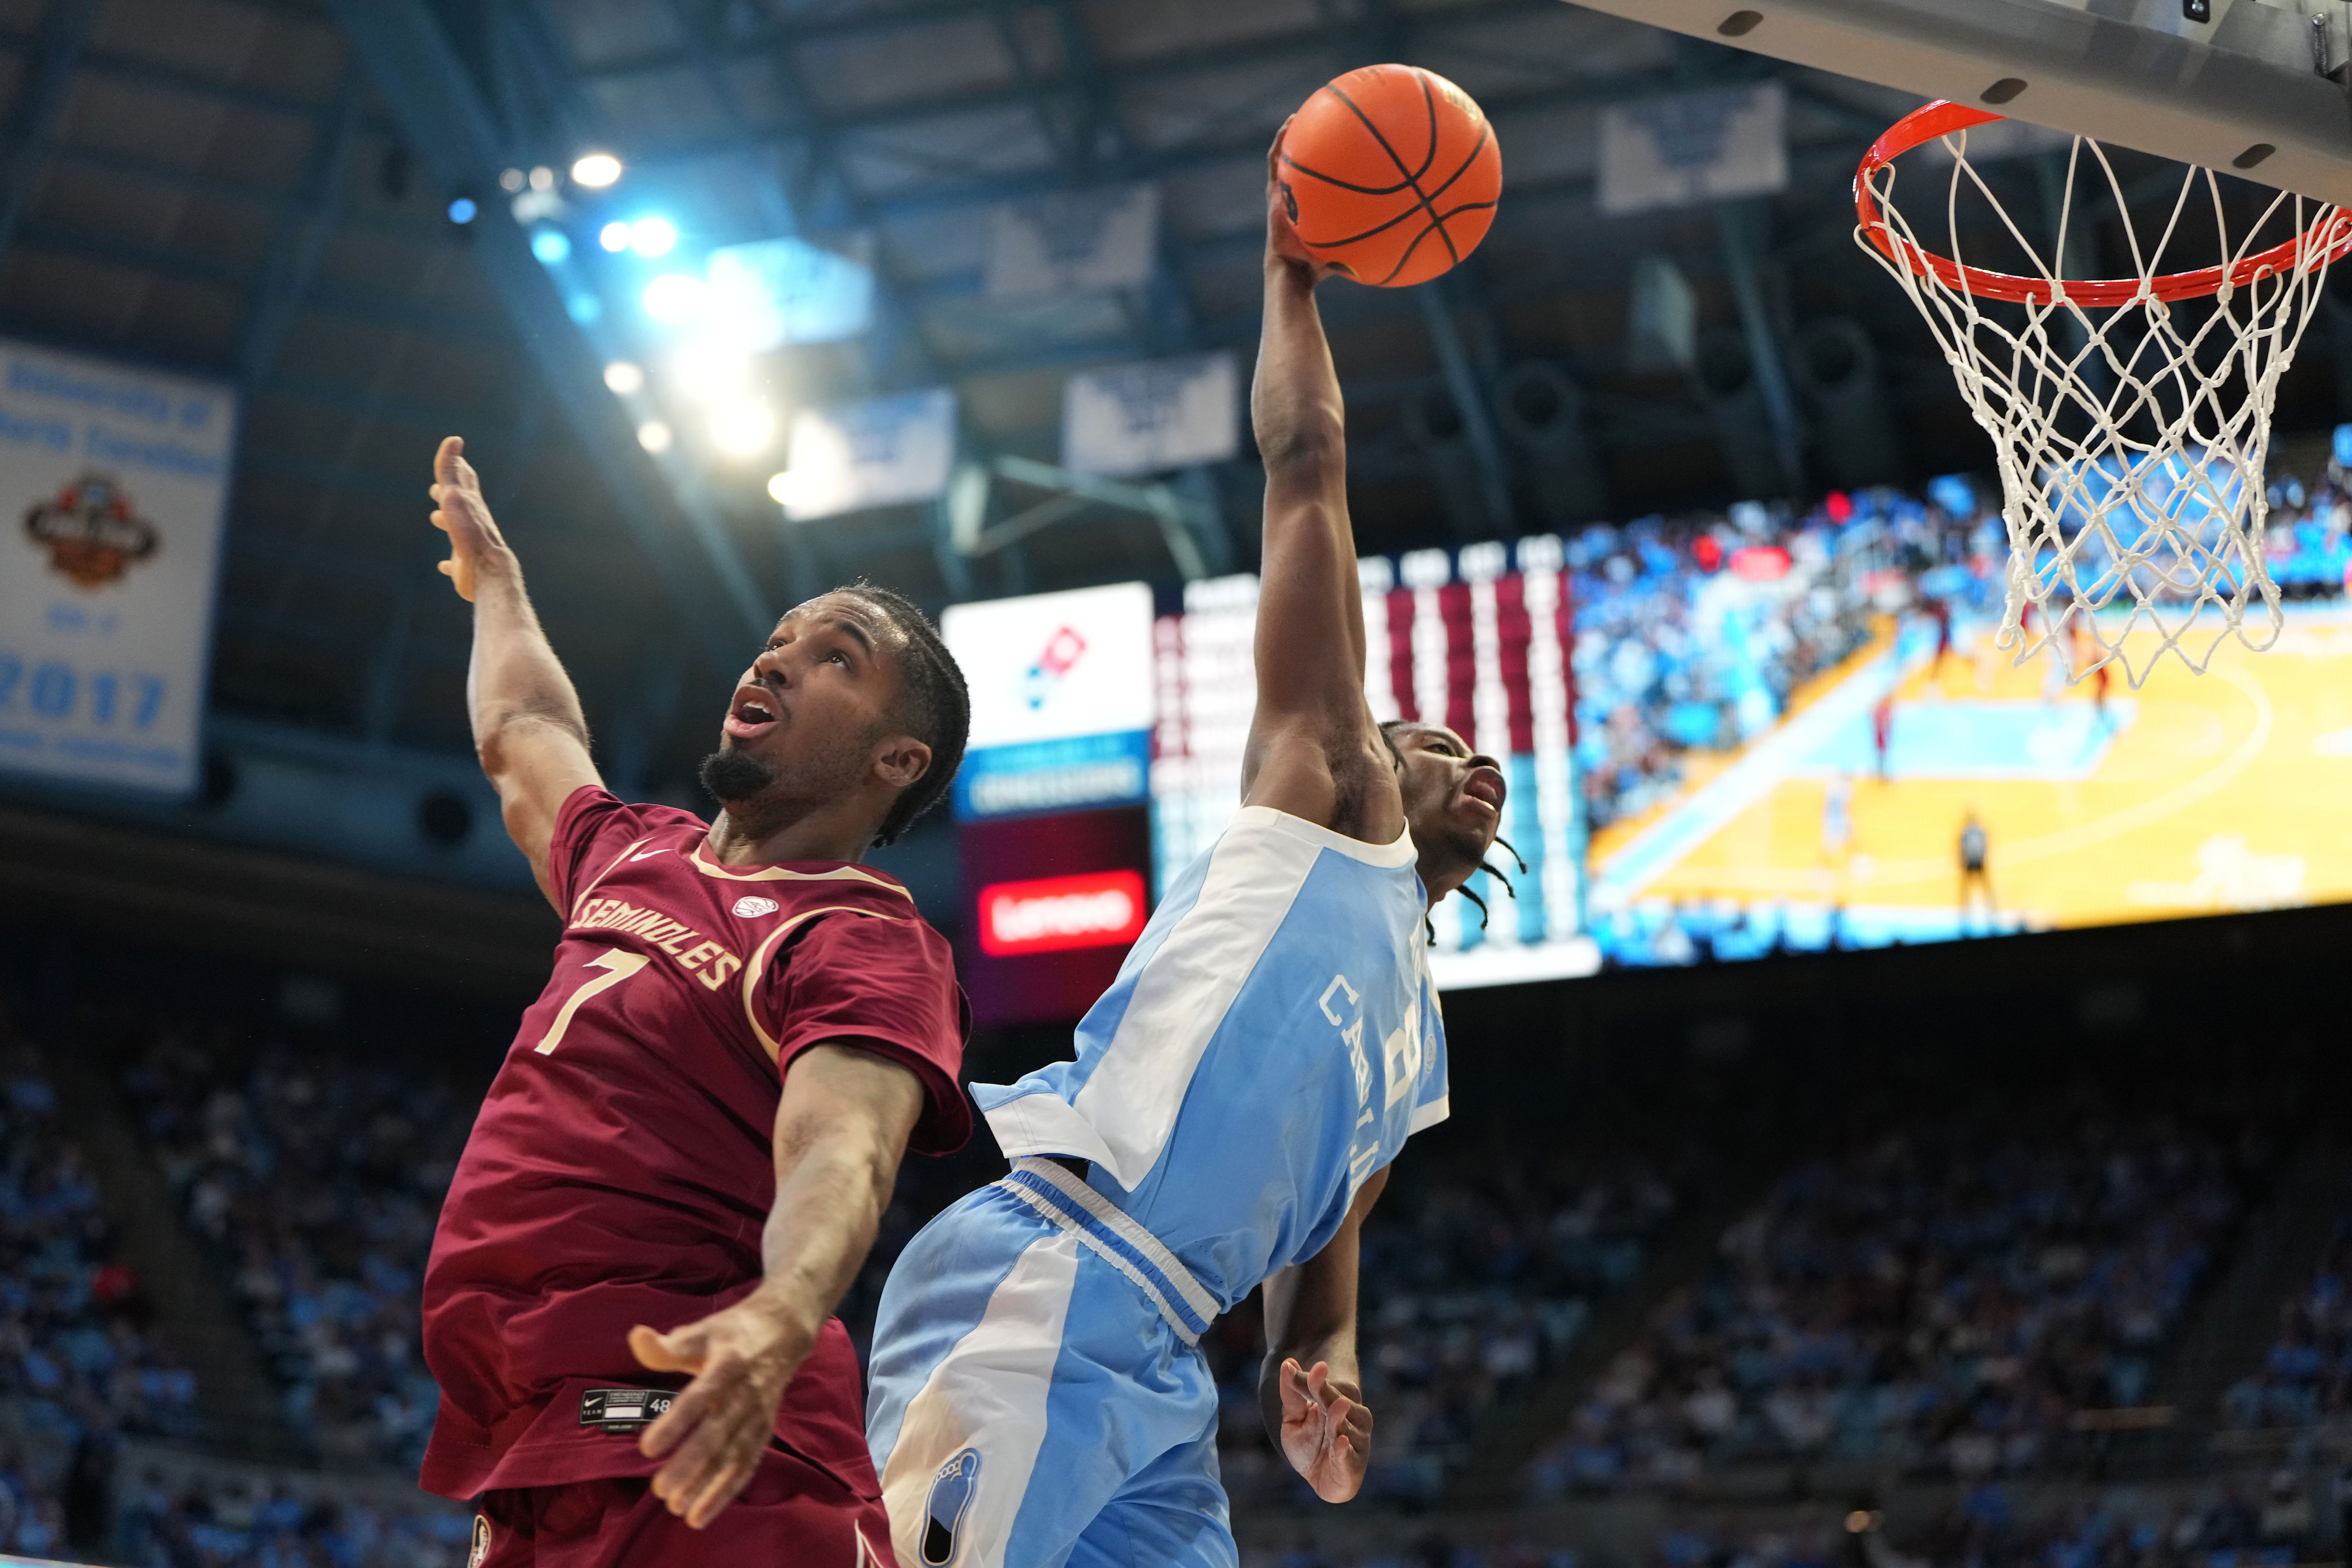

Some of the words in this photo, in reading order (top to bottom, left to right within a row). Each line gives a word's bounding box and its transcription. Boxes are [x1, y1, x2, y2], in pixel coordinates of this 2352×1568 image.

[568, 898, 742, 991] SEMINOLES
[534, 947, 651, 1055] 7
[1319, 974, 1379, 1219] CARLI
[650, 1399, 671, 1413] 48
